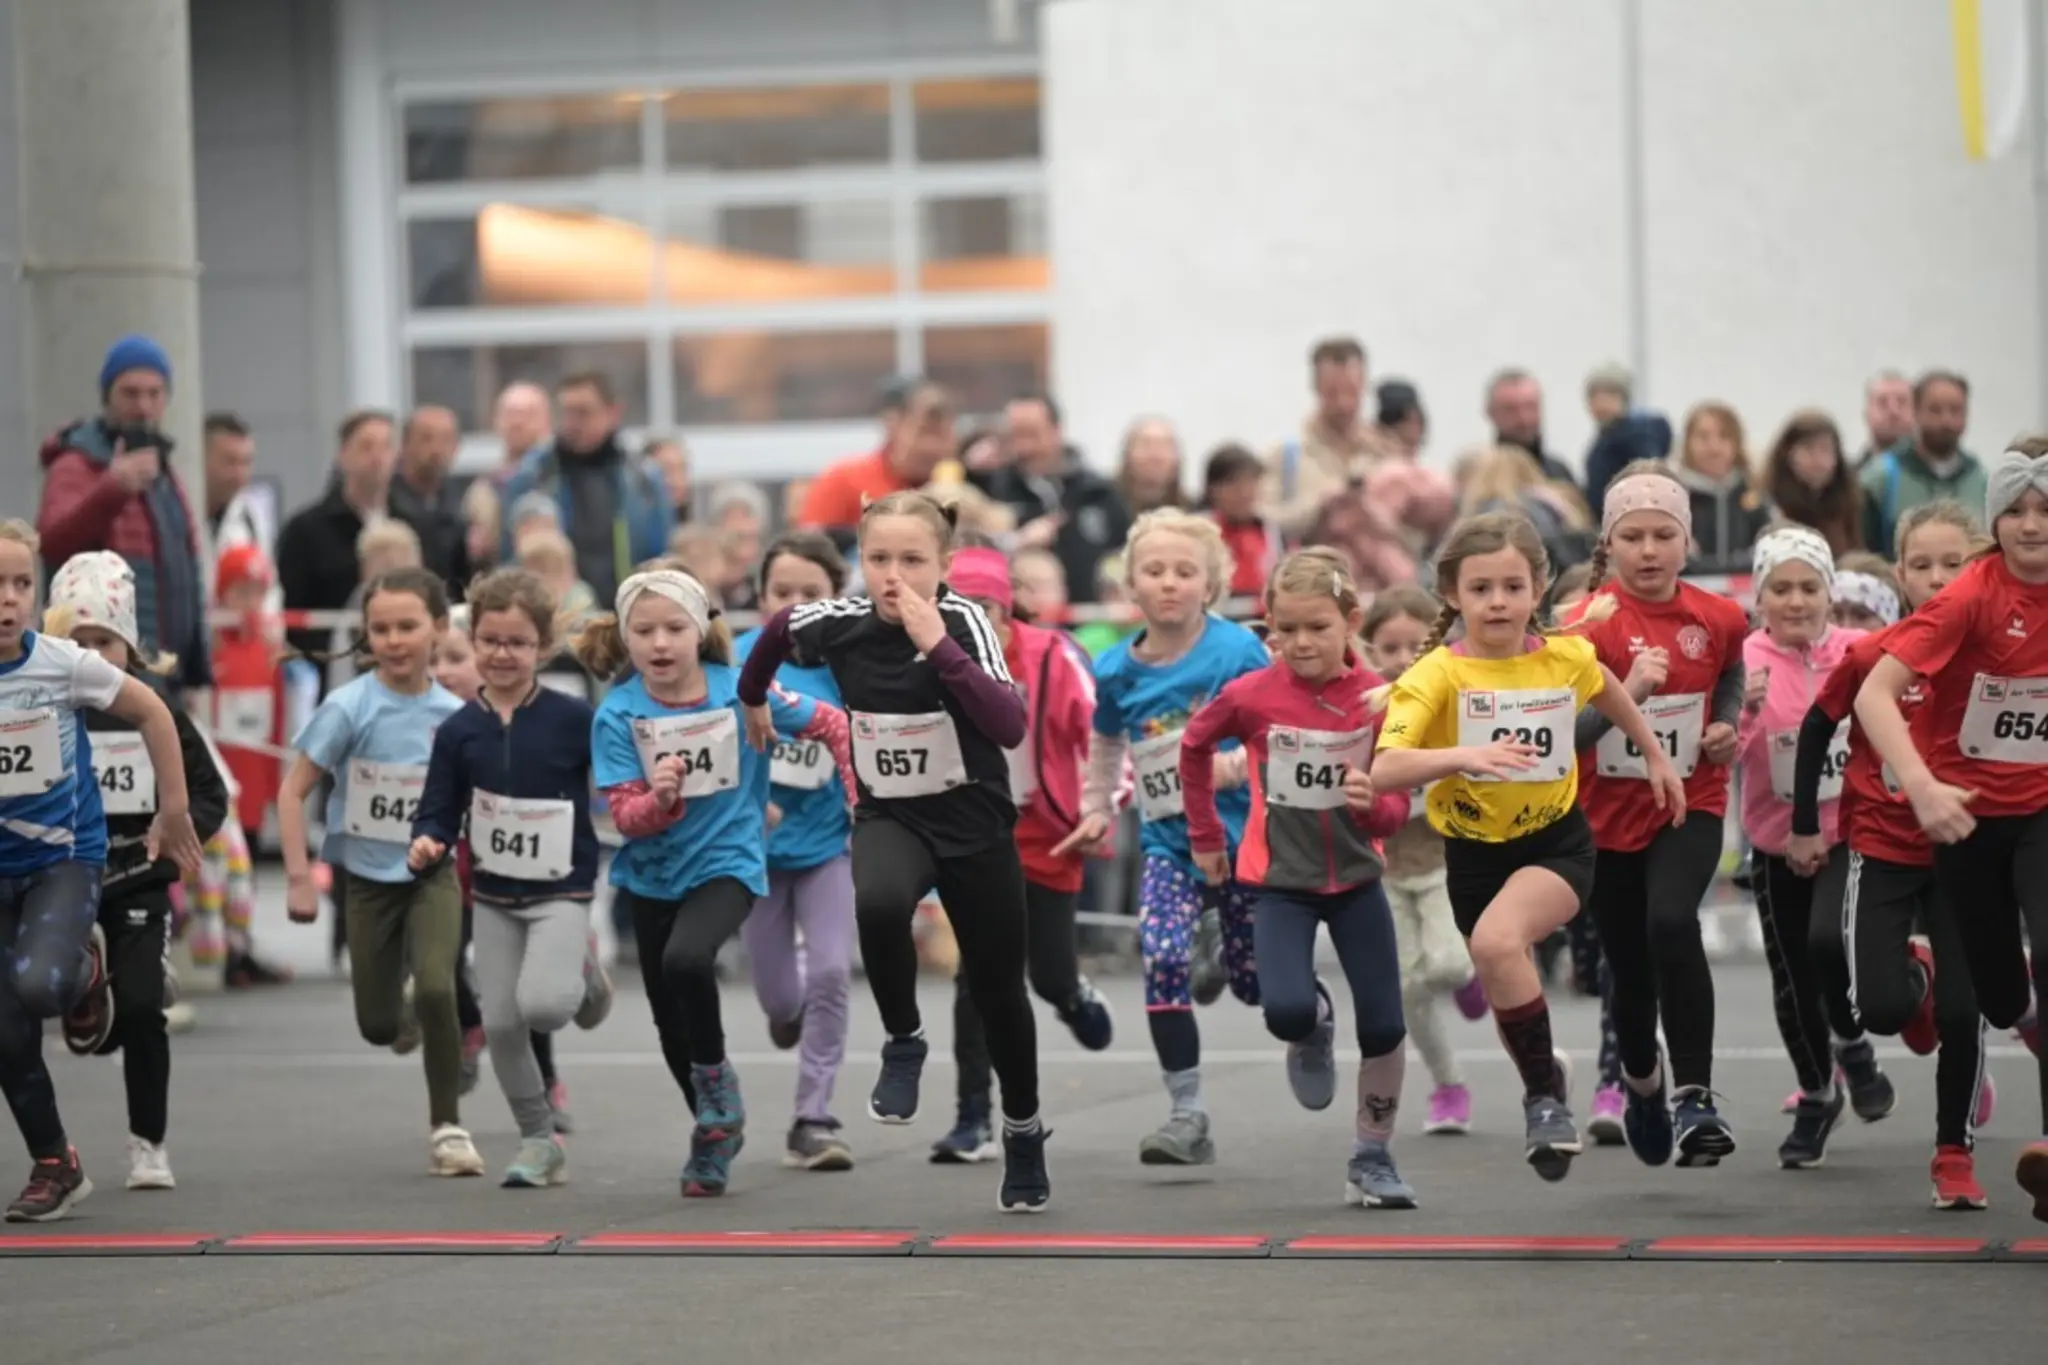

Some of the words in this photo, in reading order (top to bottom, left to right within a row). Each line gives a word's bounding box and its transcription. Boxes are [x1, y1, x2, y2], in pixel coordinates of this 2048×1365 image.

[1994, 711, 2048, 743] 654
[1625, 729, 1678, 758] 61
[876, 749, 928, 776] 657
[1295, 763, 1348, 789] 647
[91, 764, 135, 793] 43
[1141, 766, 1182, 800] 637
[490, 828, 541, 859] 641
